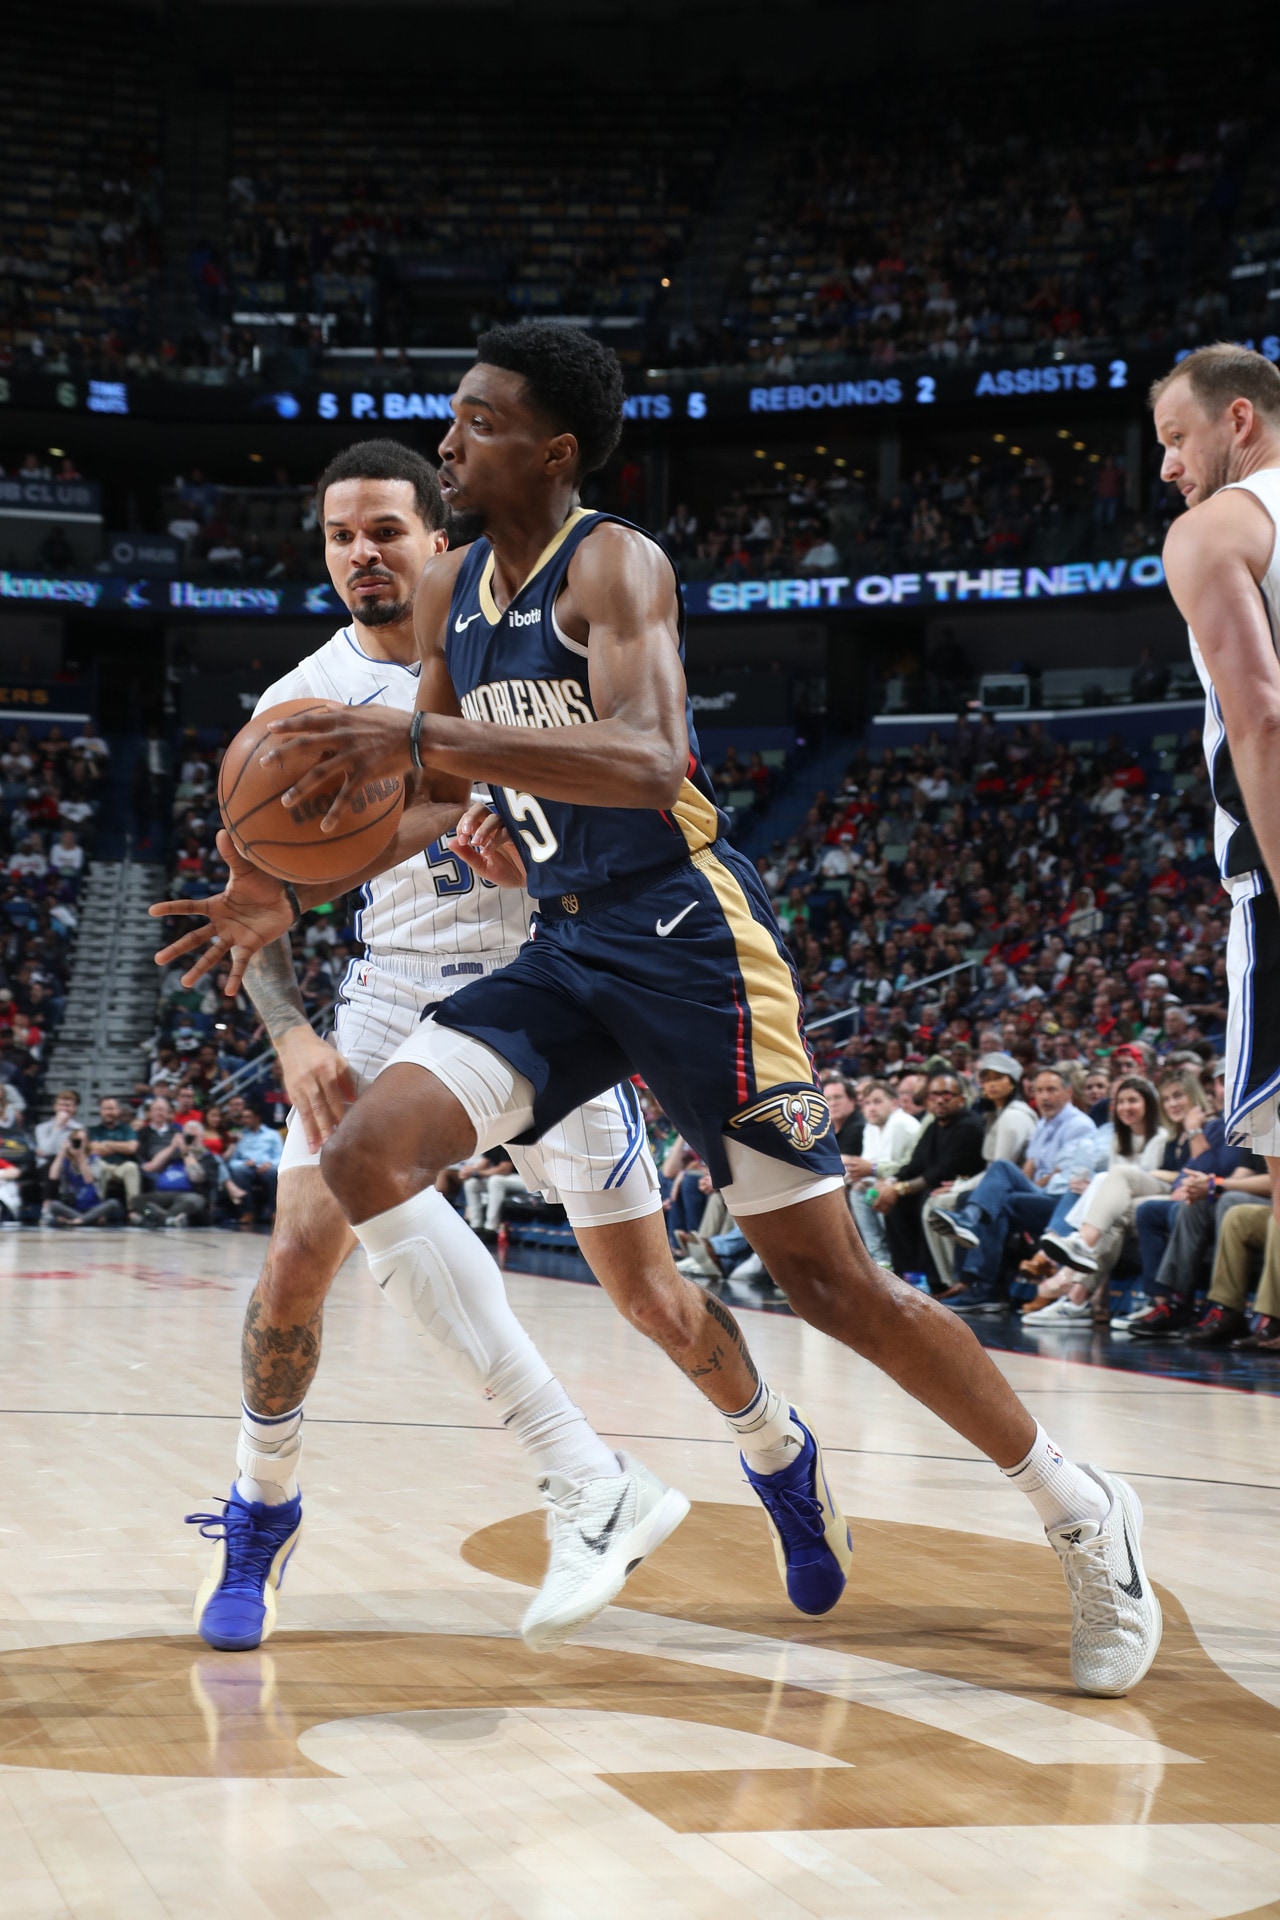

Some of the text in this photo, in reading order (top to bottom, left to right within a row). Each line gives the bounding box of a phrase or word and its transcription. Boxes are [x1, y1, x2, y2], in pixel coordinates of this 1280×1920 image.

[351, 393, 378, 418] P.
[687, 393, 707, 418] 5
[749, 379, 902, 412] REBOUNDS
[916, 376, 936, 403] 2
[975, 363, 1097, 396] ASSISTS
[1109, 360, 1128, 388] 2
[24, 484, 91, 505] CLUB
[169, 580, 282, 614] Hennessy
[708, 576, 849, 611] SPIRIT
[855, 573, 920, 604] OF
[927, 568, 1021, 601] THE
[1025, 558, 1127, 598] NEW
[508, 607, 542, 628] ibotta
[441, 962, 484, 978] ORLANDO
